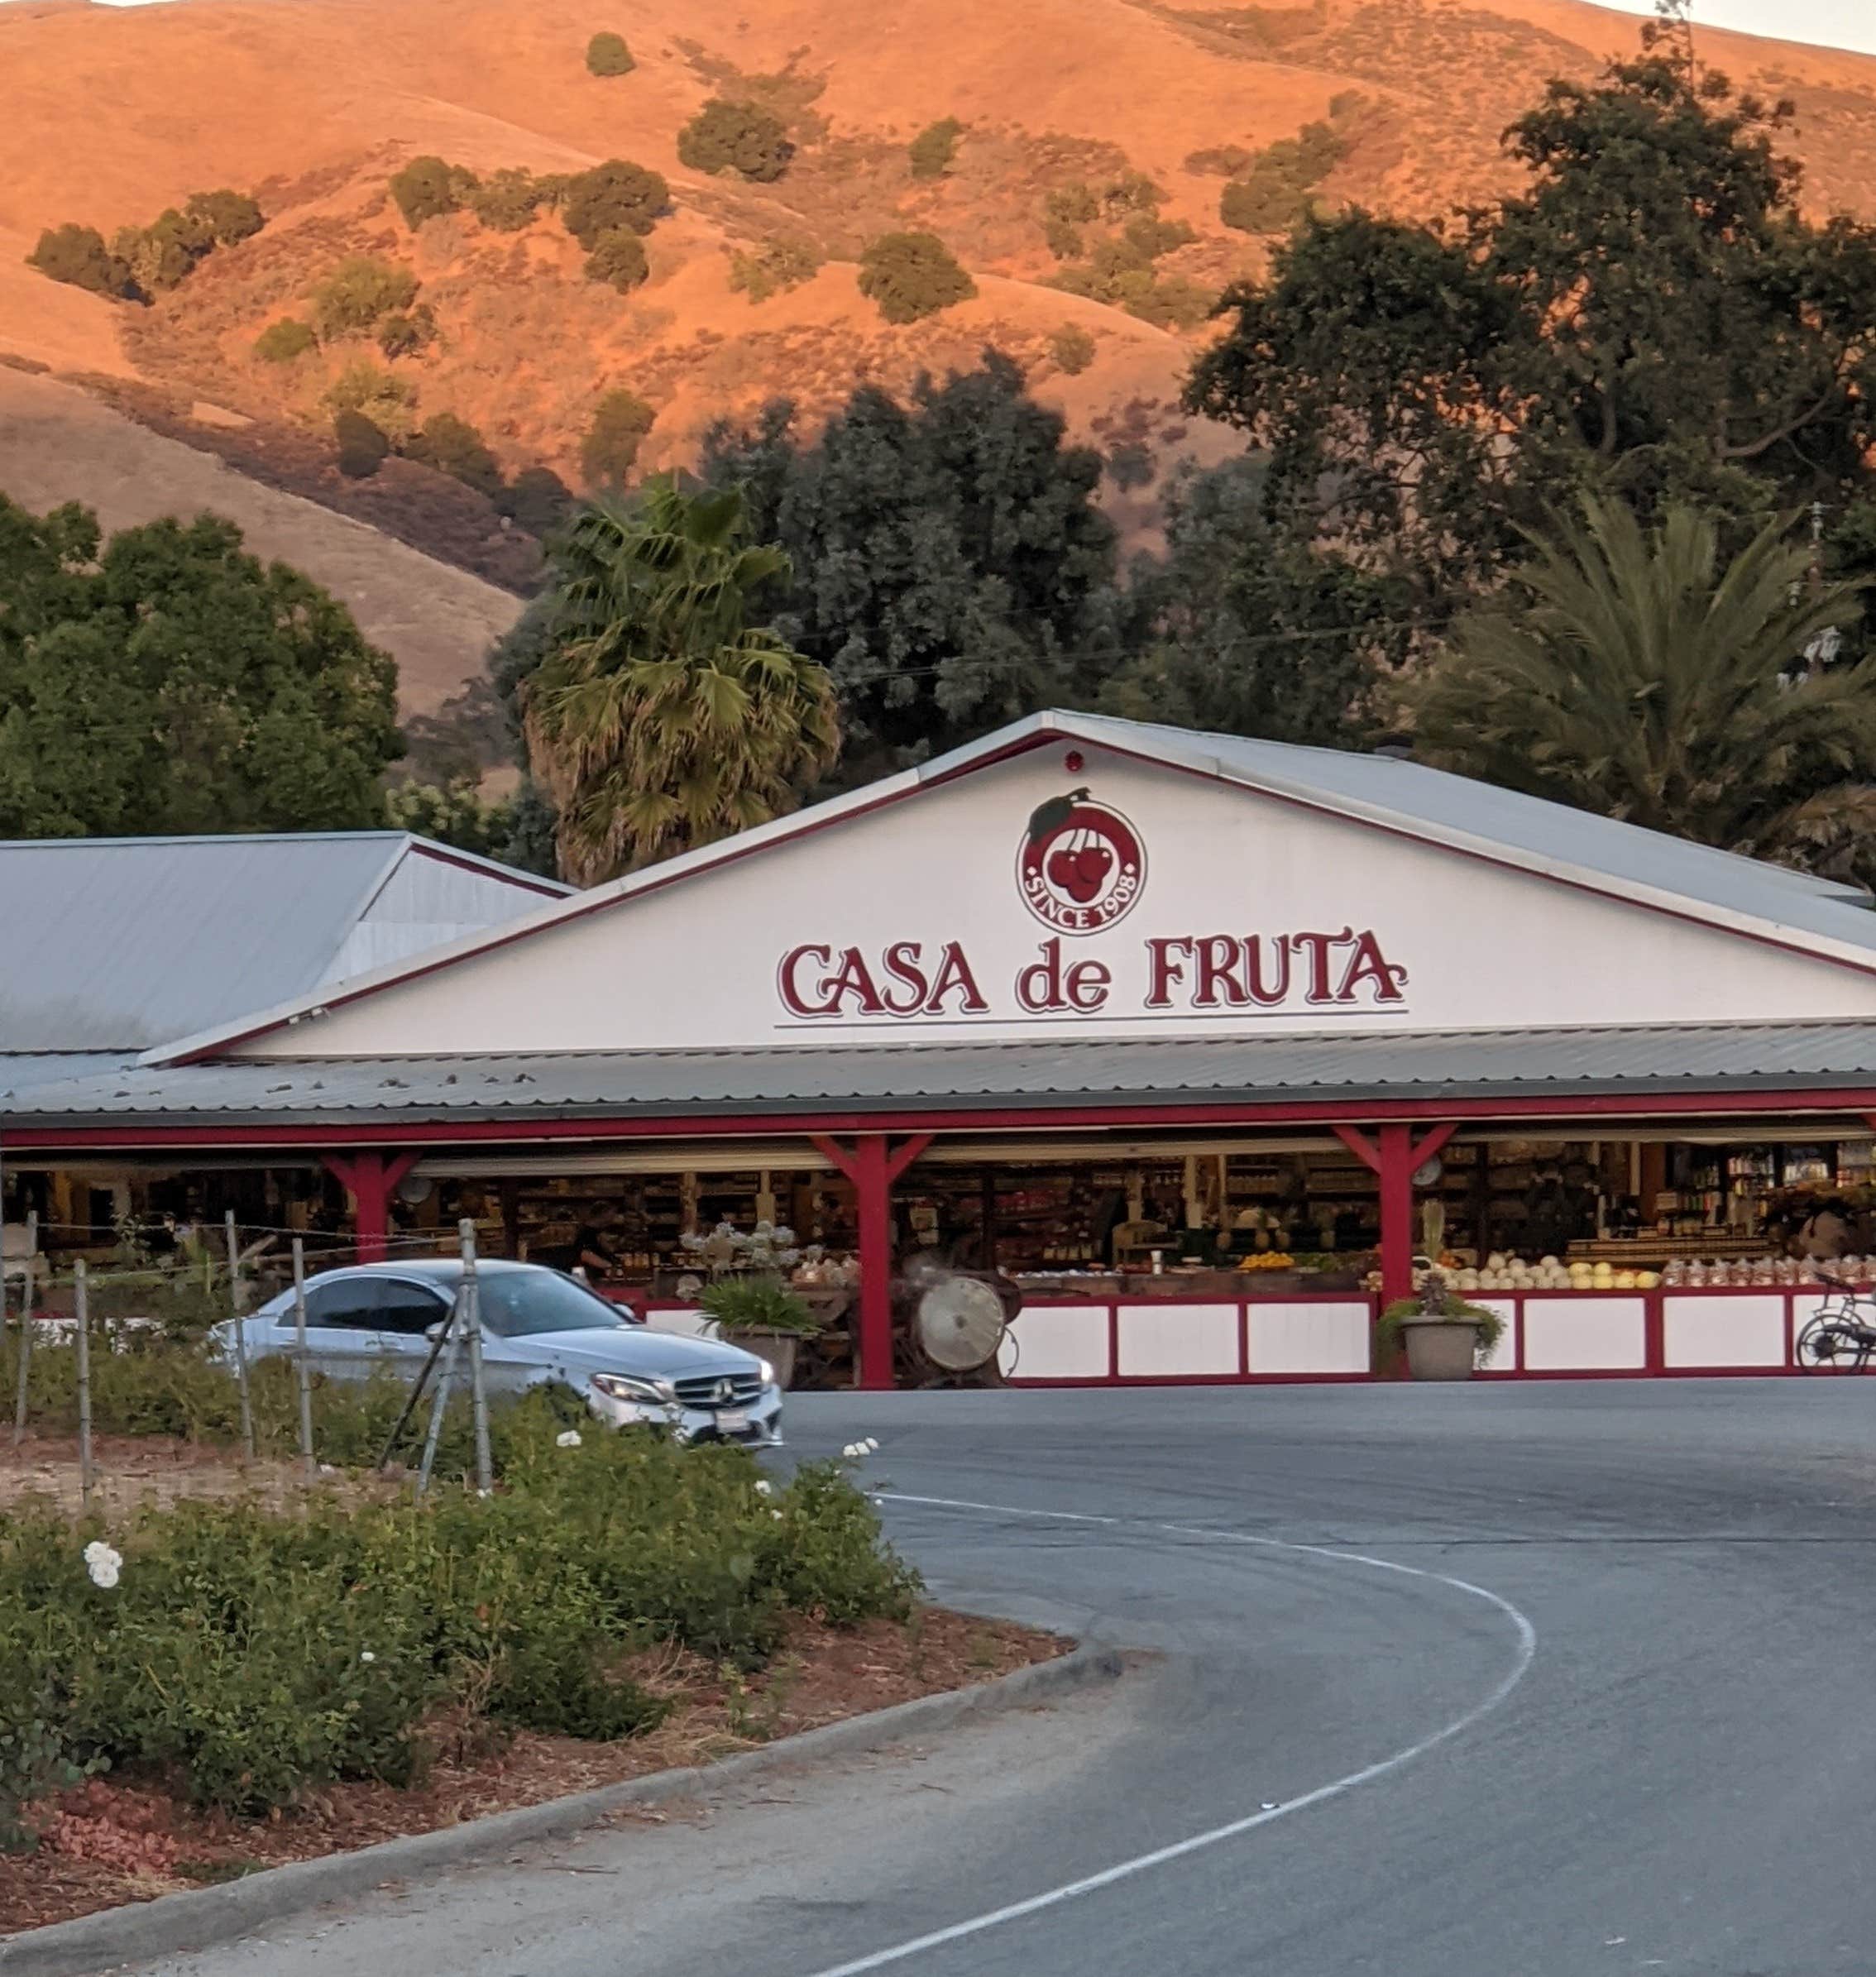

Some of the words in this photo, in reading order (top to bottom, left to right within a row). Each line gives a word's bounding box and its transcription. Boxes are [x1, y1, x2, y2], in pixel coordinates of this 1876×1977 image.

[1025, 876, 1090, 928] SINCE
[1094, 874, 1137, 923] 1908
[777, 941, 990, 1018] CASA
[1015, 936, 1112, 1014] de
[1144, 926, 1409, 1012] FRUTA
